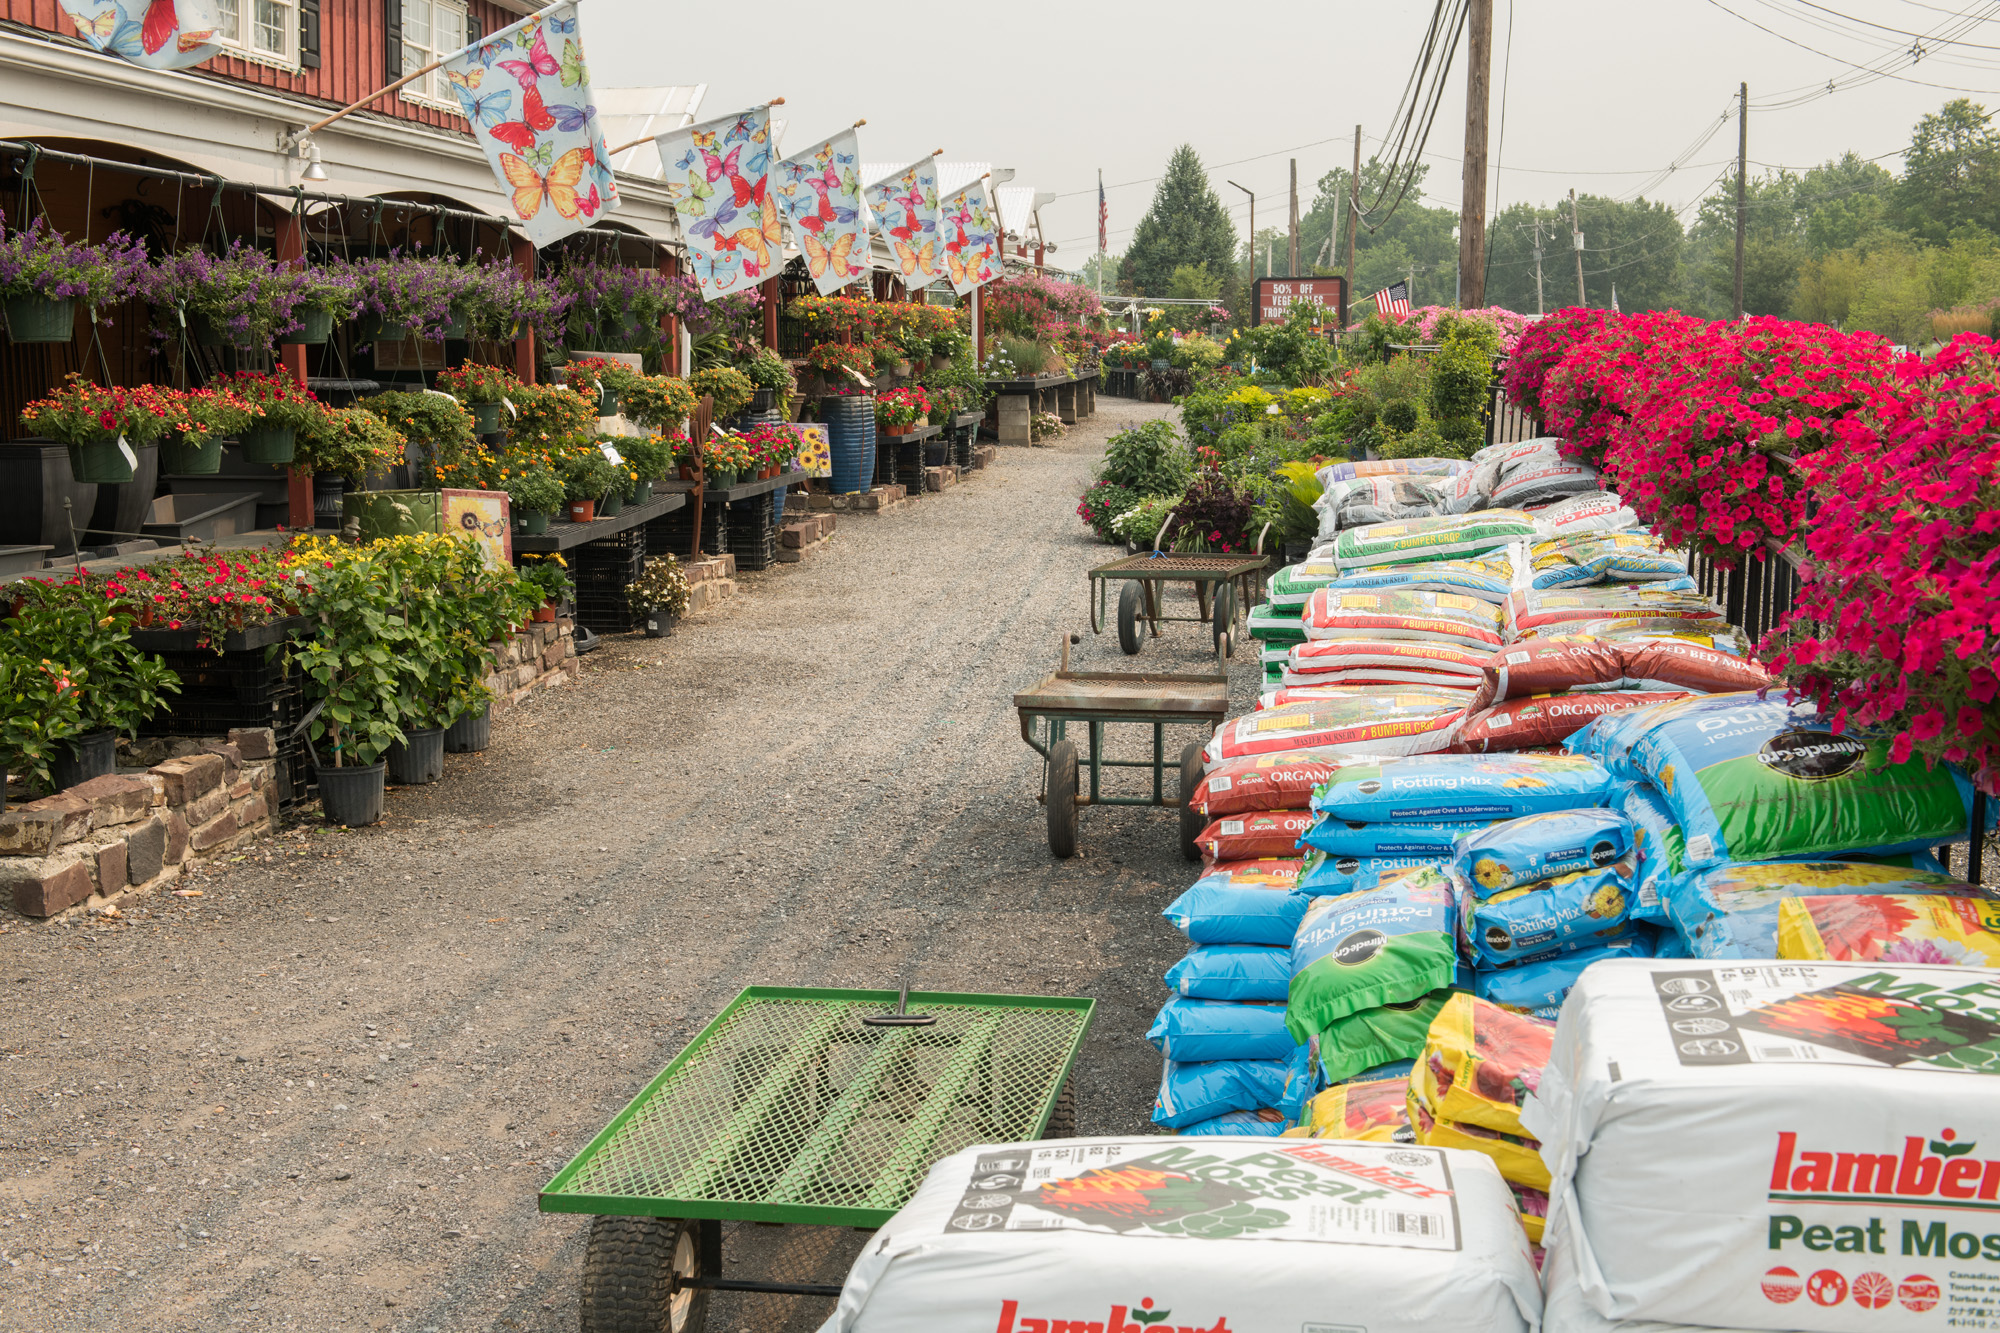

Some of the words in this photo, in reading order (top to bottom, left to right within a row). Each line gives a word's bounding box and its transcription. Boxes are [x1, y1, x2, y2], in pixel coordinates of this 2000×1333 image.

[1273, 283, 1292, 295] 50%
[1299, 283, 1314, 294] OFF
[1550, 467, 1578, 475] Four
[1495, 469, 1544, 493] Corners
[1579, 506, 1612, 518] Four
[1365, 543, 1392, 552] NURSERY
[1401, 536, 1437, 549] BUMPER
[1438, 532, 1461, 544] CROP
[1462, 527, 1489, 540] ORGANIC
[1644, 561, 1660, 570] SOIL
[1299, 582, 1325, 591] NURSERY
[1355, 577, 1381, 587] MASTER
[1382, 576, 1409, 585] NURSERY
[1412, 573, 1441, 581] ORGANIC
[1441, 574, 1470, 585] POTTING
[1470, 579, 1486, 587] SOIL
[1619, 610, 1657, 619] BUMPER
[1658, 610, 1683, 619] CROP
[1373, 618, 1399, 626] NURSERY
[1408, 619, 1444, 632] BUMPER
[1446, 623, 1469, 635] CROP
[1400, 646, 1438, 659] BUMPER
[1440, 649, 1464, 661] CROP
[1535, 652, 1564, 660] ORGANIC
[1569, 643, 1635, 659] ORGANC
[1690, 650, 1719, 664] BED
[1723, 657, 1752, 671] MIX
[1549, 702, 1617, 717] ORGANIC
[1516, 712, 1544, 721] ORGANIC
[1293, 734, 1323, 746] MASTER
[1324, 730, 1357, 744] NURSERY
[1370, 722, 1412, 738] BUMPER
[1414, 720, 1436, 735] CROP
[1708, 723, 1783, 745] Control
[1757, 741, 1866, 764] Miracle-Gro
[1237, 776, 1266, 786] ORGANIC
[1392, 777, 1458, 789] Potting
[1460, 776, 1493, 786] Mix
[1392, 810, 1418, 818] Protects
[1418, 808, 1441, 817] Against
[1464, 805, 1510, 814] Underwatering
[1250, 823, 1279, 832] ORGANIC
[1377, 844, 1403, 852] Protects
[1404, 844, 1426, 852] Against
[1569, 848, 1584, 856] Twice
[1530, 856, 1537, 866] 8
[1517, 868, 1541, 881] Mix
[1541, 860, 1590, 876] Potting
[1340, 906, 1433, 927] Potting
[1358, 916, 1410, 928] Moisture
[1509, 916, 1558, 936] Potting
[1556, 907, 1581, 923] Mix
[1297, 921, 1336, 949] Mix
[1563, 924, 1571, 933] 8
[1314, 925, 1356, 948] Control
[1518, 939, 1535, 947] Twice
[1332, 935, 1388, 959] Miracle-Gro
[1569, 942, 1576, 950] 8
[1548, 994, 1556, 1004] 8
[1141, 1145, 1312, 1201] Moss
[1281, 1143, 1456, 1199] lambert
[1226, 1151, 1392, 1205] Peat
[1768, 1214, 1886, 1255] Peat
[1948, 1270, 2000, 1281] Canadian
[1948, 1282, 1985, 1292] Tourbe
[1948, 1294, 1978, 1303] Turba
[1981, 1296, 1995, 1305] de
